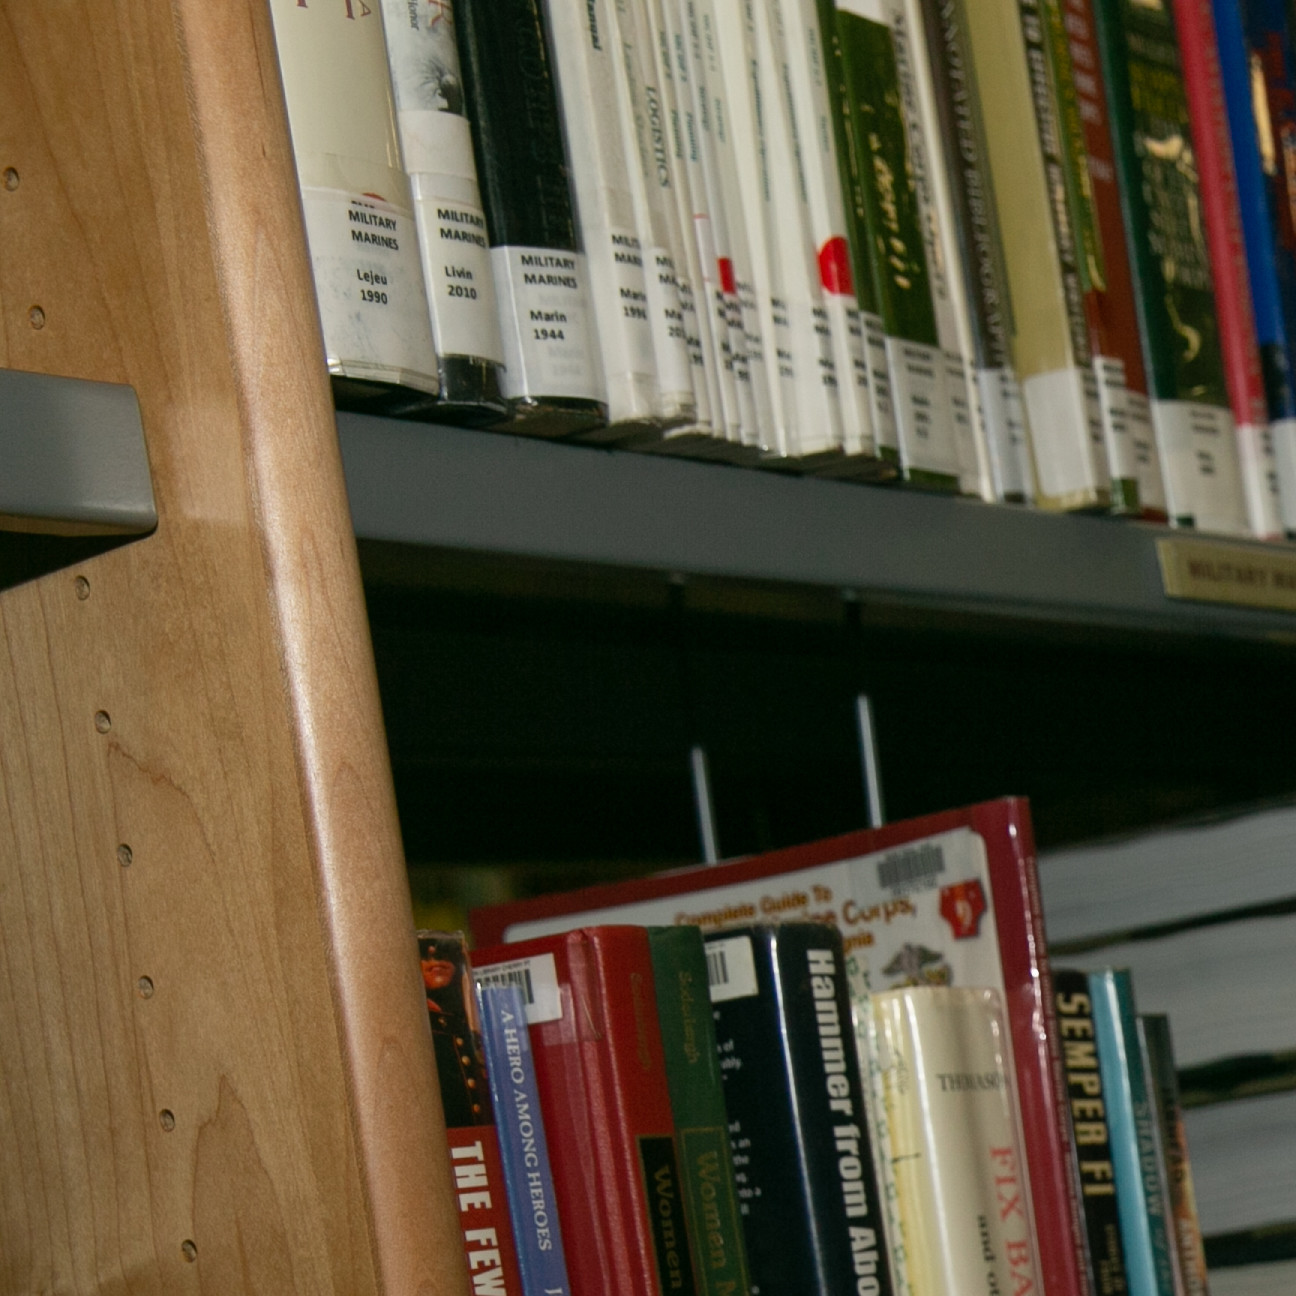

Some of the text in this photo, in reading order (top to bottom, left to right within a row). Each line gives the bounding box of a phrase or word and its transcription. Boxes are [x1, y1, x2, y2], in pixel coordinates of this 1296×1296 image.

[646, 86, 670, 188] LOGISTICS
[348, 209, 397, 231] MILITARY
[437, 208, 484, 228] MILITARY
[351, 228, 399, 250] MARINES
[439, 227, 486, 248] MARINES
[444, 266, 473, 280] Livin
[521, 254, 576, 270] MILITARY
[356, 268, 388, 285] Lejeu
[524, 272, 577, 289] MARINES
[360, 289, 388, 304] 1990
[447, 285, 477, 300] 2010
[530, 309, 567, 323] Marin
[533, 329, 565, 341] 1944
[806, 949, 853, 1117] Hammer
[833, 1124, 869, 1219] from
[1056, 992, 1116, 1196] SEMPER FI
[501, 1009, 553, 1251] A HERO AMONG HEROES
[451, 1141, 493, 1212] THE
[989, 1144, 1025, 1222] FIX
[697, 1150, 727, 1269] Women
[654, 1164, 682, 1290] Women
[977, 1214, 996, 1264] and
